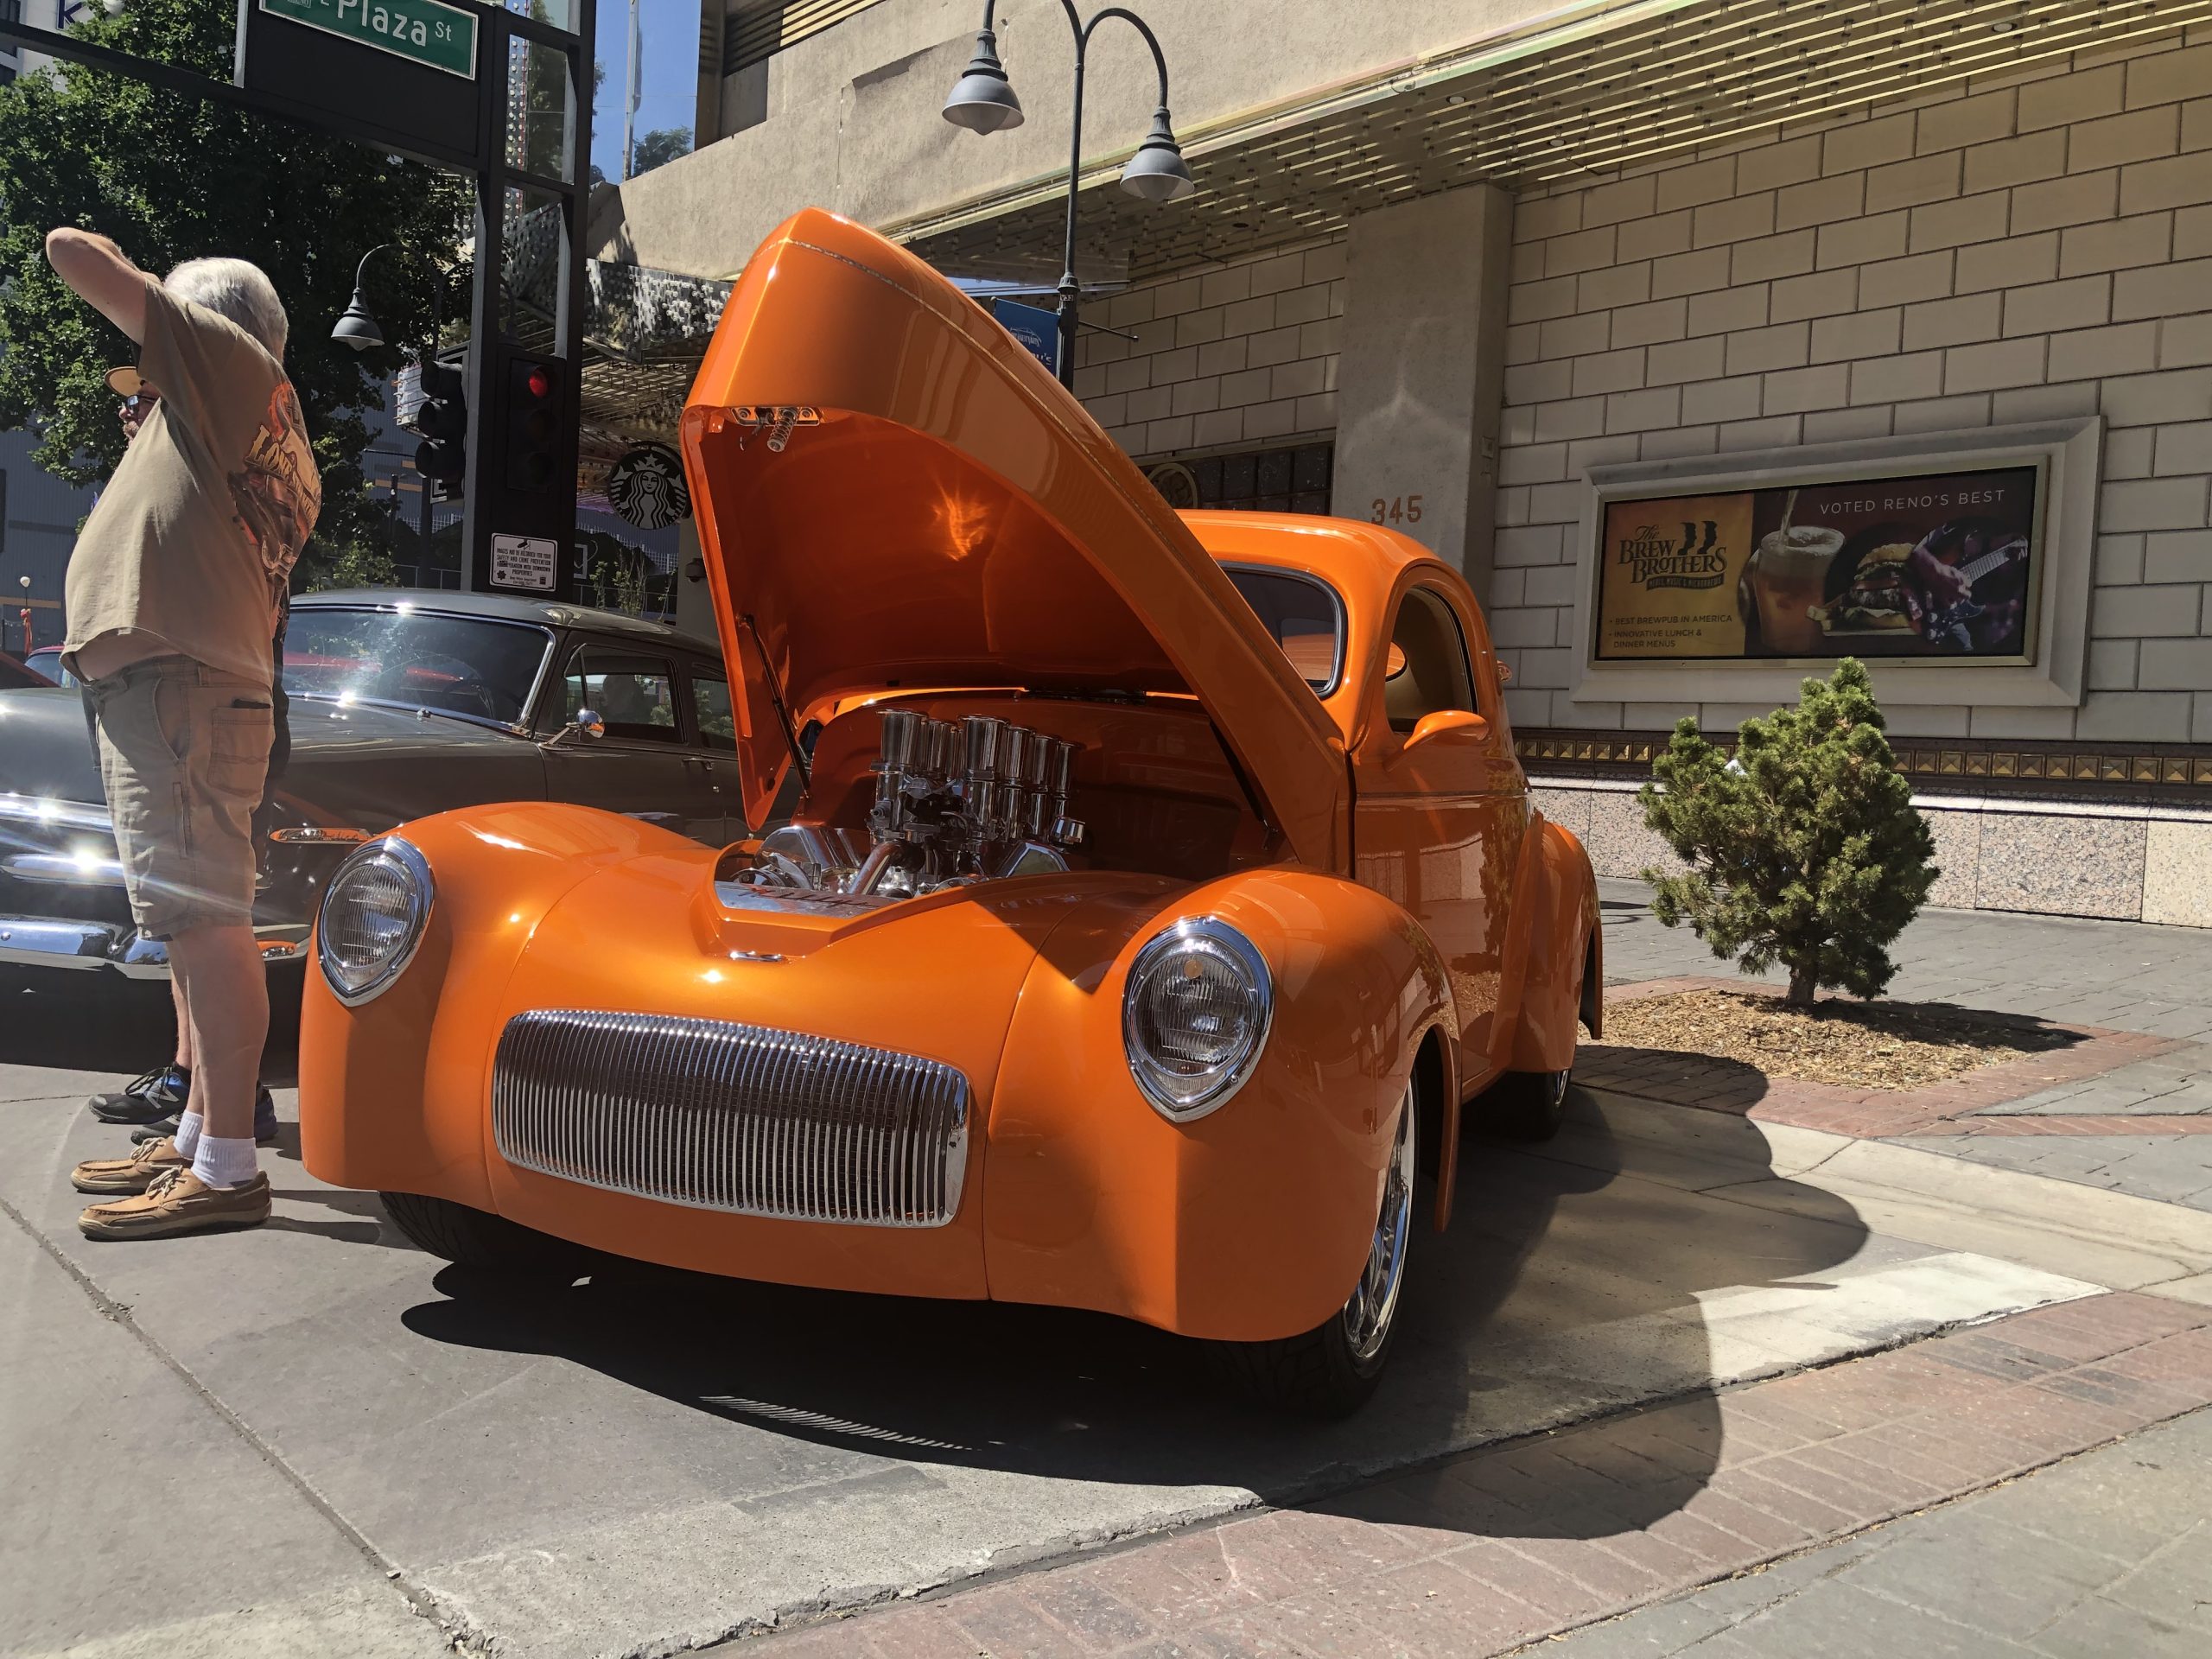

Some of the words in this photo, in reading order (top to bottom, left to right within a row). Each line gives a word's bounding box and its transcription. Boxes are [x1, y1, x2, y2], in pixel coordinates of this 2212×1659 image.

[337, 0, 428, 47] Plaza
[435, 21, 451, 41] St
[1370, 495, 1422, 526] 345
[1820, 499, 1876, 515] VOTED
[1884, 493, 1949, 511] RENO'S
[1958, 489, 2005, 505] BEST
[1635, 524, 1660, 541] The
[1618, 539, 1677, 564] BREW
[1630, 546, 1727, 583] BROTHERS
[1637, 615, 1678, 624] BREWPUB
[1692, 614, 1732, 623] AMERICA
[1614, 629, 1663, 638] INNOVATIVE
[1646, 639, 1676, 648] MENUS
